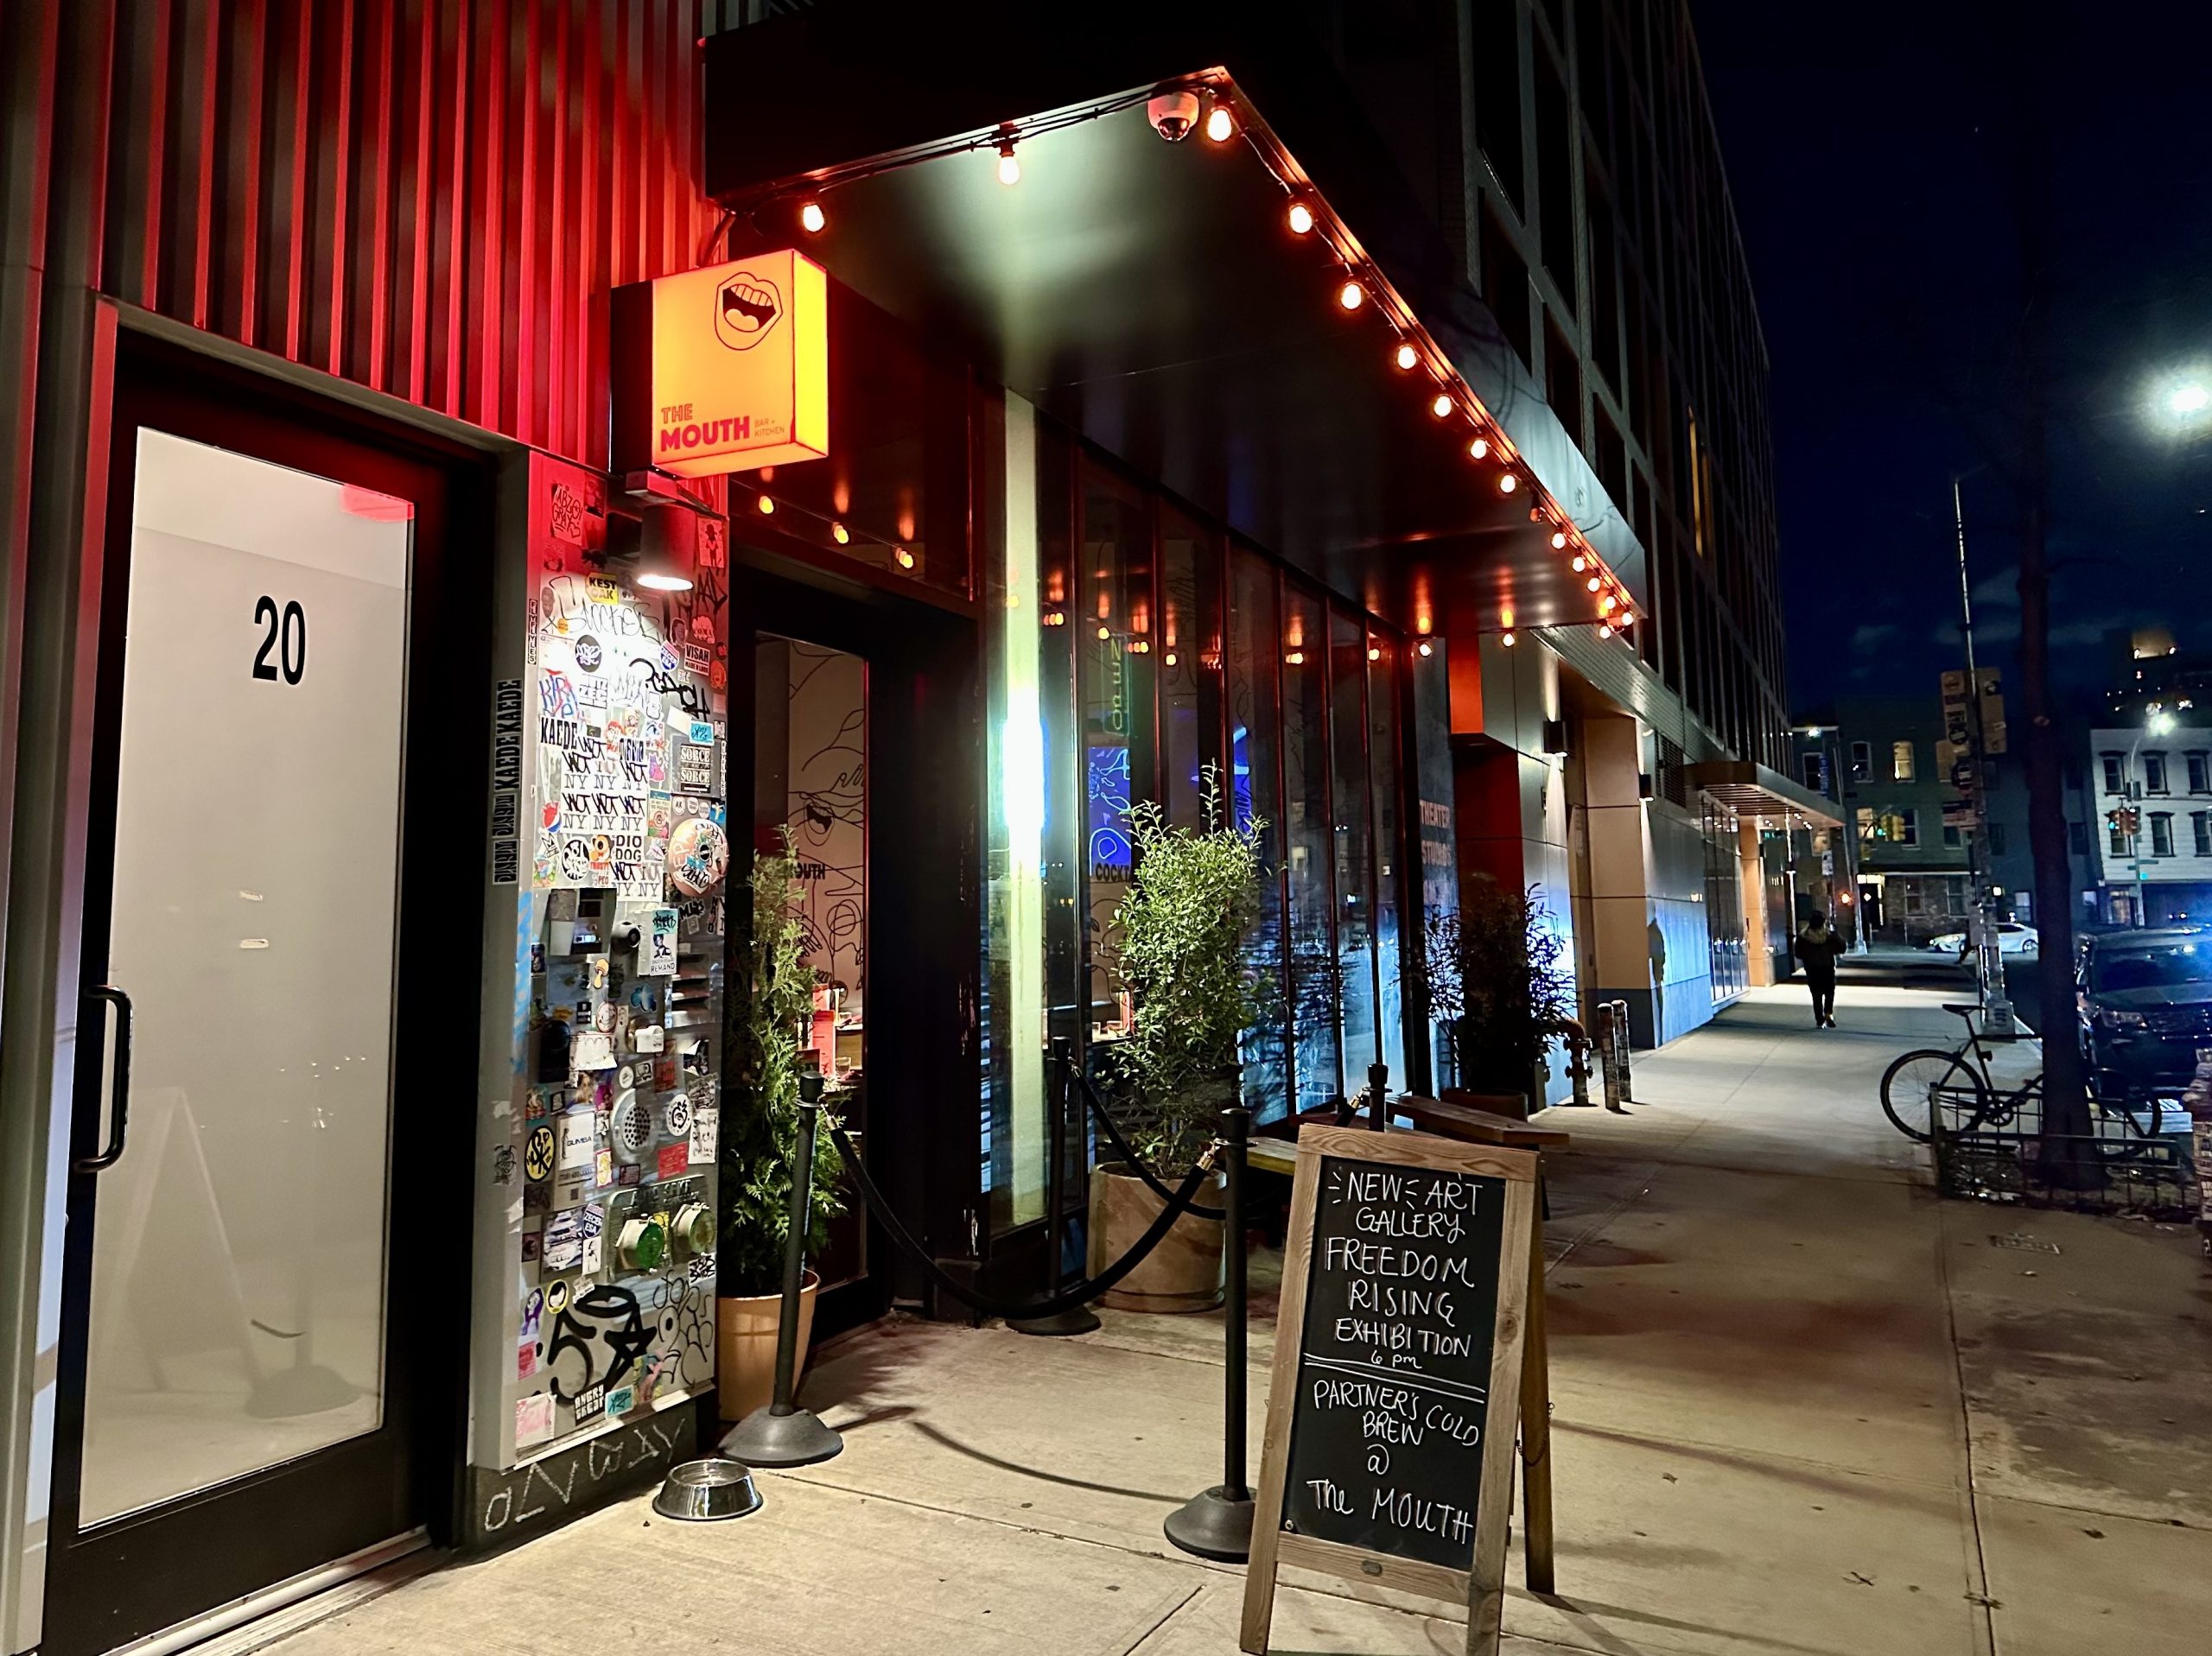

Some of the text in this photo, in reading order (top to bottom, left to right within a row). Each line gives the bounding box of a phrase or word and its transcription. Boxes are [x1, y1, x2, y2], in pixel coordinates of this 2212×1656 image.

[661, 403, 692, 424] THE
[754, 418, 769, 428] BAR
[661, 416, 750, 452] MOUTH
[754, 427, 785, 437] KITCHEN
[252, 595, 306, 685] 20
[497, 680, 522, 733] KAEDE
[541, 717, 577, 750] KAEDE
[495, 736, 520, 790] KAEDE
[564, 774, 588, 789] NY
[594, 774, 617, 790] NY
[563, 814, 643, 832] NY NY NY
[1420, 799, 1450, 829] THEATER
[616, 835, 642, 847] DIO
[616, 848, 641, 862] DOG
[787, 863, 825, 879] OUTH
[1096, 862, 1130, 883] COCKT
[639, 883, 660, 897] NY
[1348, 1172, 1483, 1215] NEW ART
[1356, 1207, 1465, 1243] GALLERY
[1325, 1237, 1474, 1287] FREEDOM
[1349, 1279, 1455, 1327] RISING
[1335, 1318, 1471, 1357] EXHIBITION
[1371, 1349, 1422, 1369] 6 pm
[1313, 1380, 1479, 1446] PARTNER'S COLD
[1363, 1412, 1423, 1445] BREW
[1368, 1444, 1389, 1475] @
[1372, 1488, 1473, 1545] MOUTH
